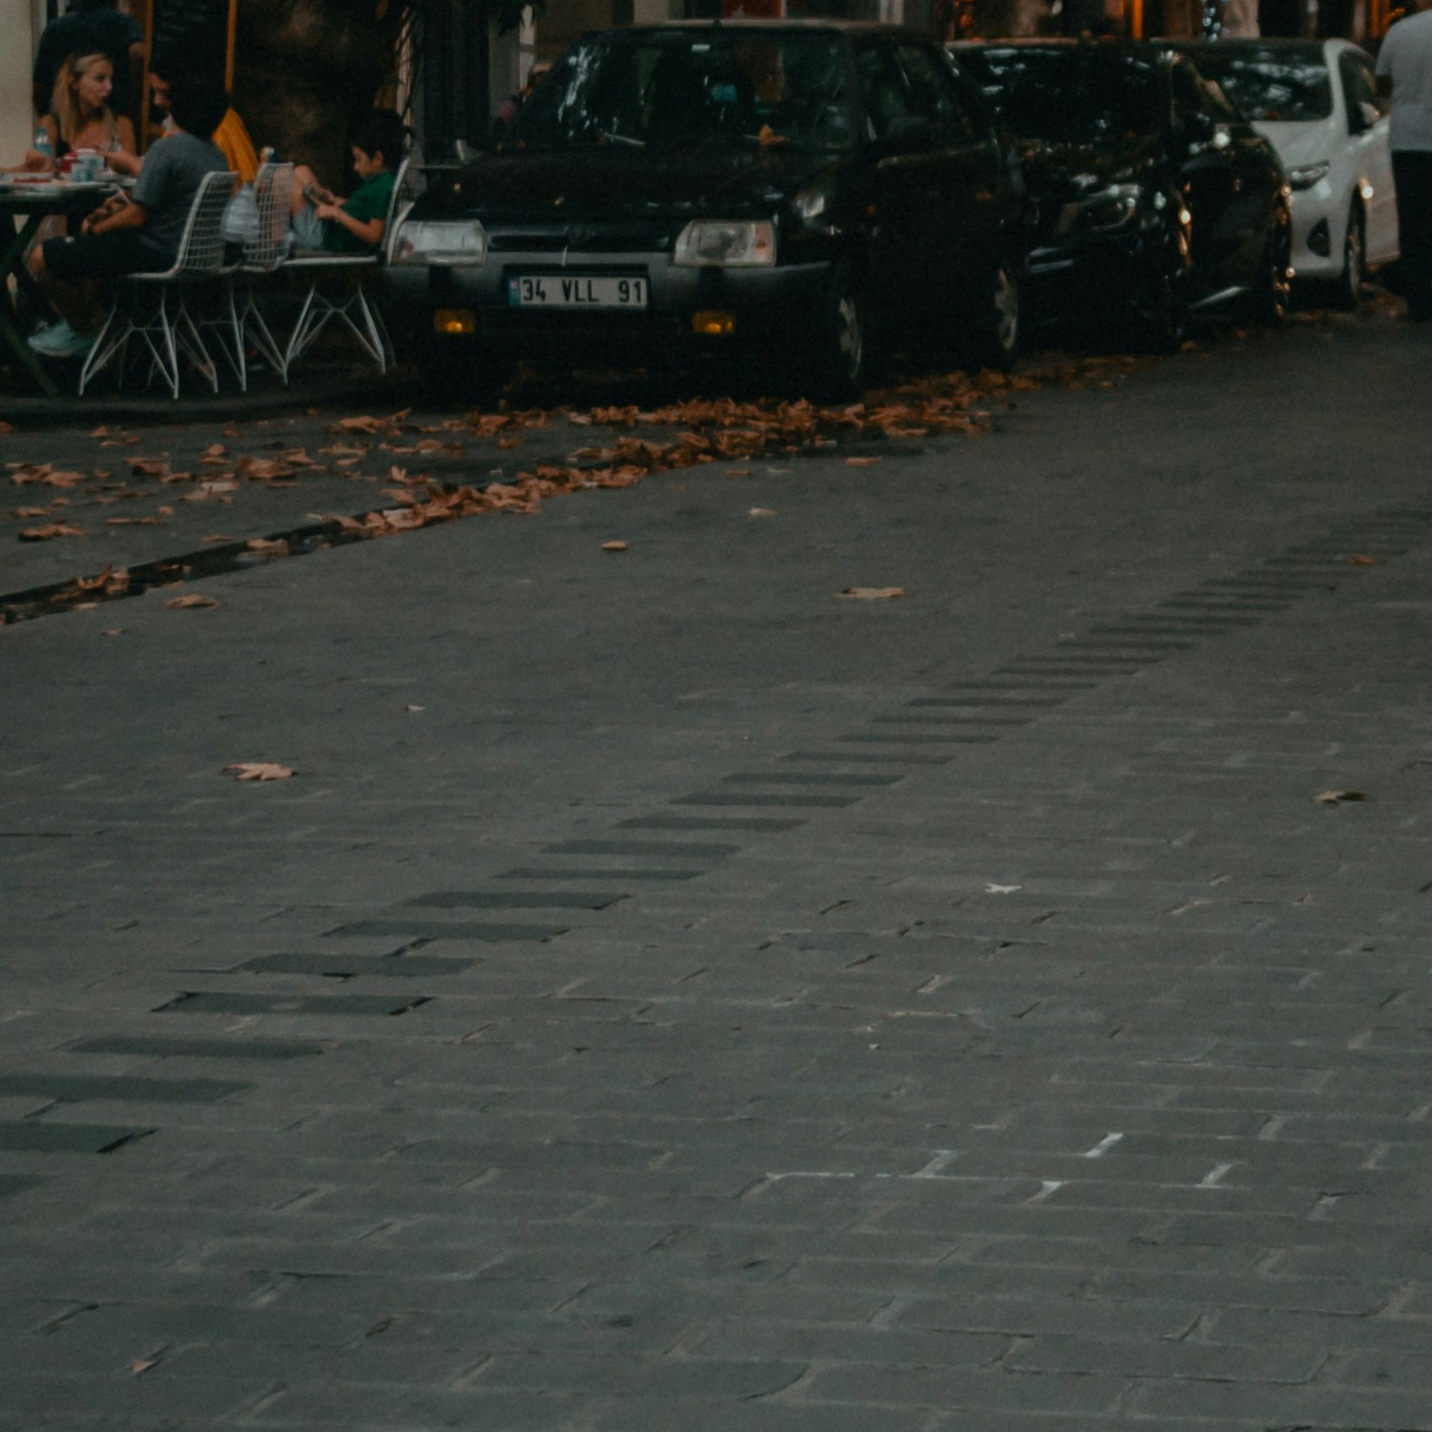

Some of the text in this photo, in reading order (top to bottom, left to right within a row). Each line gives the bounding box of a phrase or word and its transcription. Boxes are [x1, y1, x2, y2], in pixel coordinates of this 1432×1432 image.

[522, 279, 642, 303] 34 VLL 91
